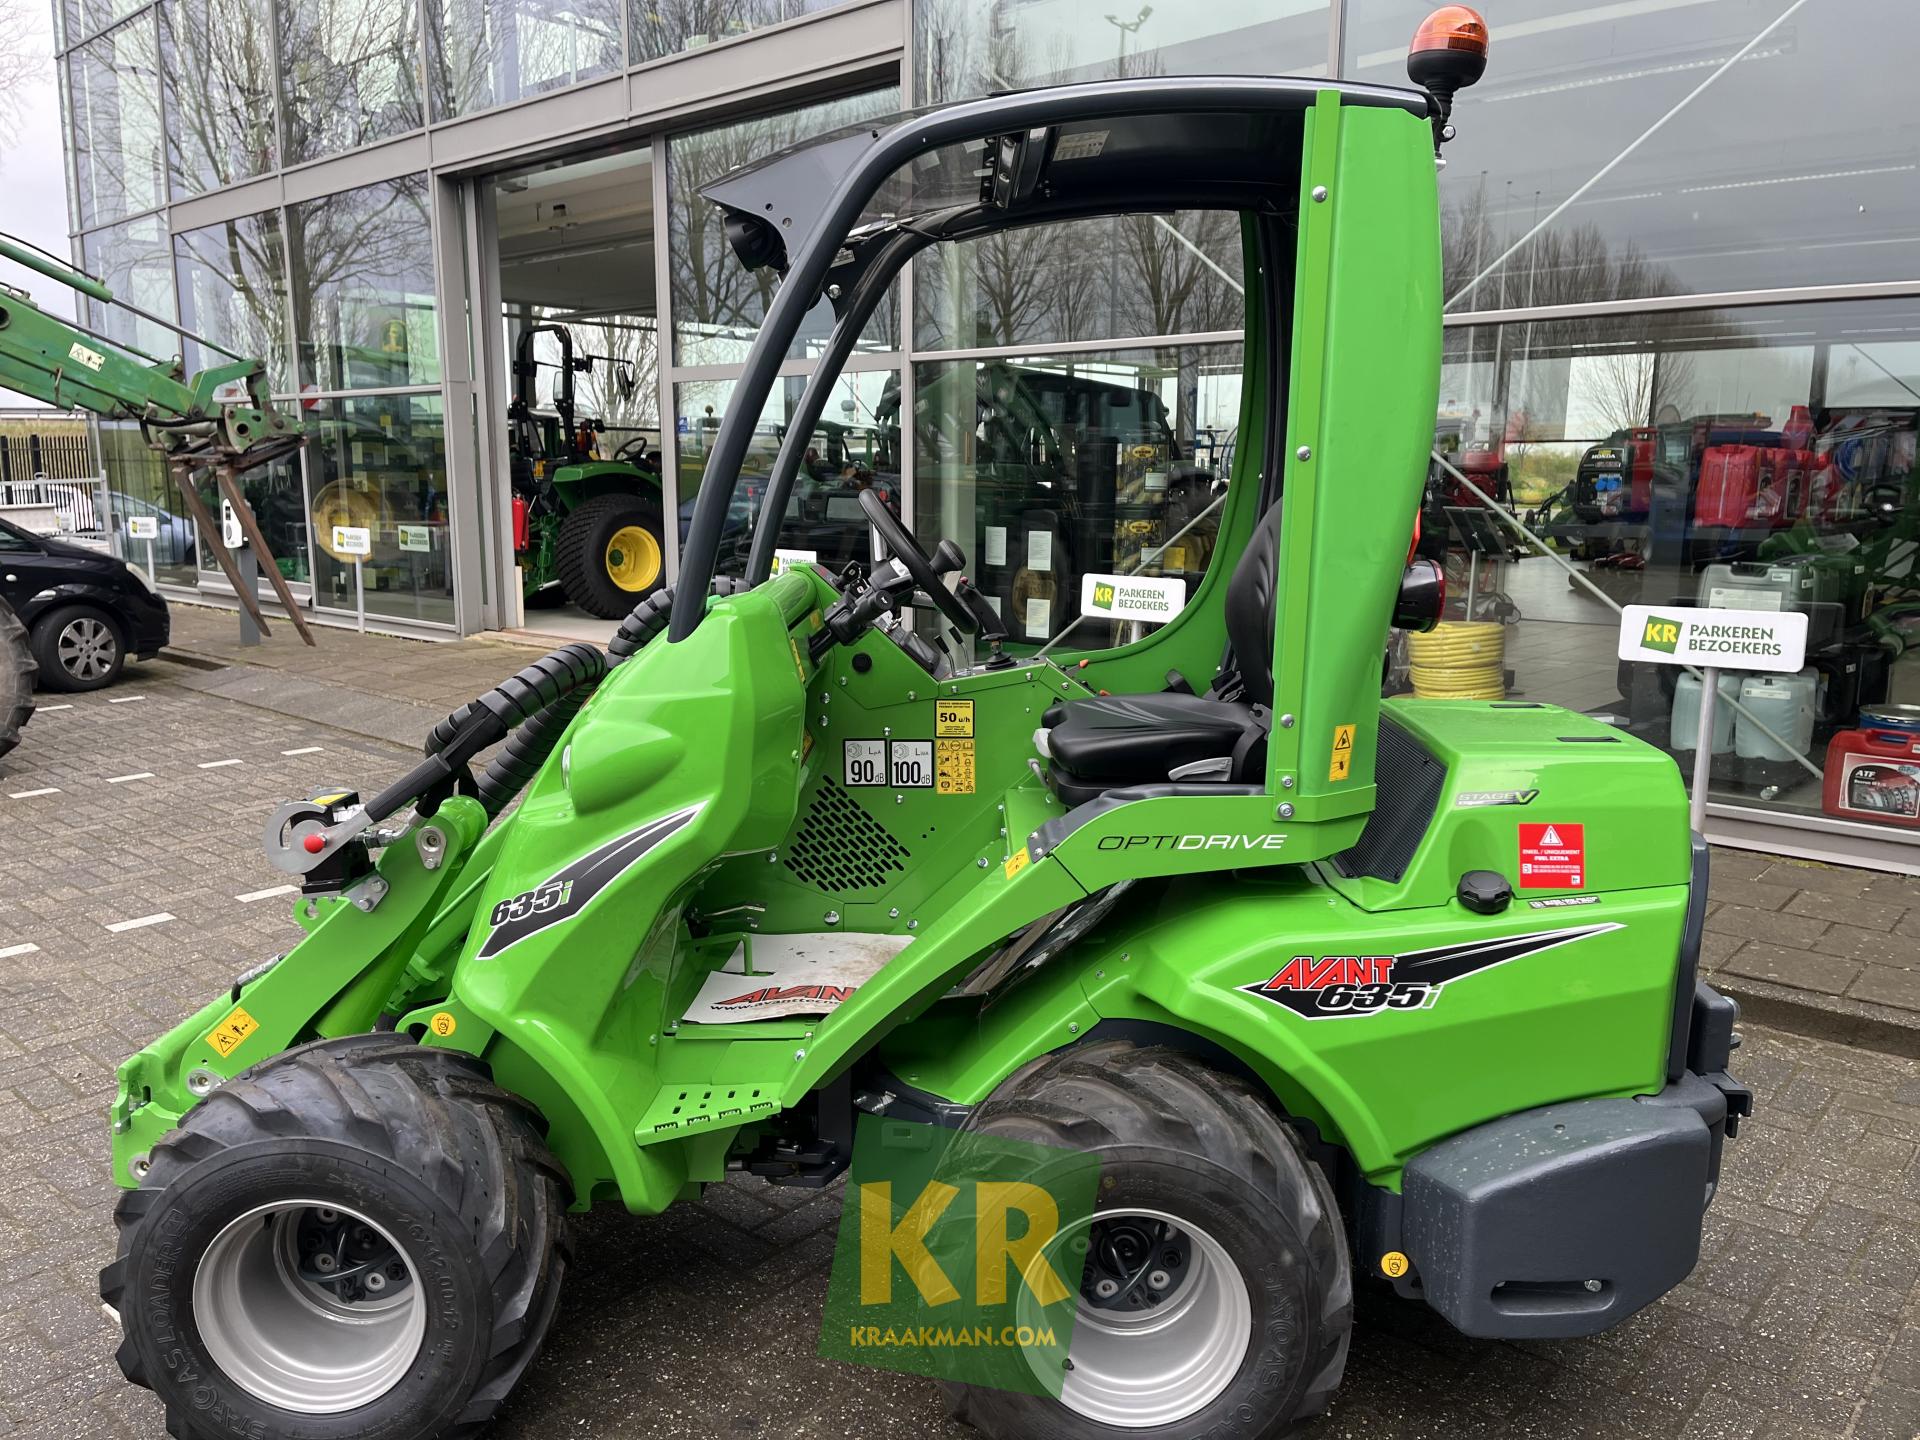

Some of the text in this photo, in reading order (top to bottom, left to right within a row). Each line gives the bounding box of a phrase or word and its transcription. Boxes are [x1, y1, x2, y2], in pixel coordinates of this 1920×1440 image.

[1094, 587, 1113, 602] KR
[1119, 588, 1165, 599] PARKEREN
[1118, 599, 1169, 611] BEZOEKERS
[1645, 623, 1677, 643] KR
[1689, 624, 1774, 640] PARKEREN
[1688, 639, 1782, 656] BEZOEKERS
[940, 712, 957, 723] 50
[1855, 769, 1876, 778] ATF
[1097, 834, 1288, 850] OPTIDRIVE
[489, 880, 574, 928] 635i
[1262, 956, 1396, 991] AVANT
[714, 985, 856, 1005] AVAN
[1316, 982, 1445, 1011] 635i
